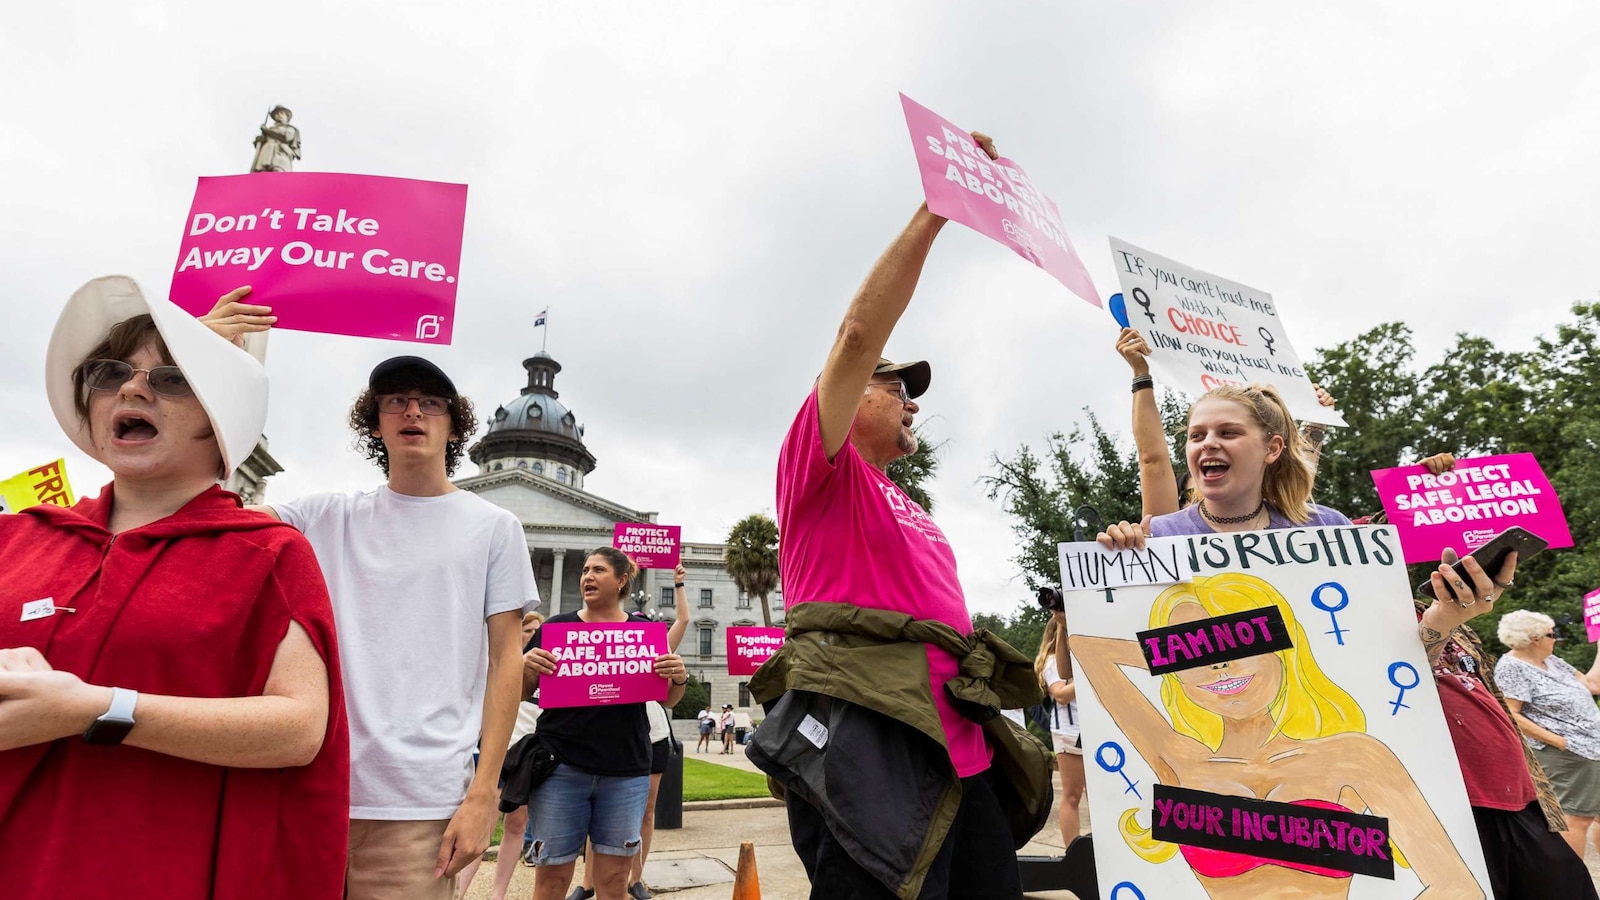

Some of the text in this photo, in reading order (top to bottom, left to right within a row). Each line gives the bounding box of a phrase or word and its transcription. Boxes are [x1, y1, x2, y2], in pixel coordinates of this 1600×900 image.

[926, 136, 1003, 189] SAFE,
[190, 208, 380, 236] Don't Take
[945, 164, 1069, 253] ABORTION
[178, 241, 455, 284] Away Our Care.
[1149, 267, 1178, 290] you
[1180, 276, 1216, 298] can't
[1216, 285, 1248, 309] trust
[1250, 298, 1276, 316] me
[1167, 307, 1248, 347] CHOICE
[1186, 341, 1212, 360] can
[1213, 348, 1240, 365] you
[1240, 353, 1274, 373] trust
[1277, 363, 1305, 378] me
[28, 460, 71, 508] FRE
[1406, 464, 1511, 491] PROTECT
[1395, 480, 1541, 510] SAFE, LEGAL
[1413, 498, 1538, 527] ABORTION
[618, 535, 676, 546] SAFE, LEGAL
[626, 527, 669, 537] PROTECT
[620, 543, 672, 554] ABORTION
[1233, 527, 1395, 569] RIGHTS
[1065, 544, 1180, 588] HUMAN
[567, 630, 645, 645] PROTECT
[735, 635, 781, 646] Together
[738, 646, 765, 658] Fight
[1145, 616, 1273, 667] I AM NOT
[551, 645, 659, 661] SAFE, LEGAL
[557, 660, 652, 677] ABORTION
[1156, 798, 1389, 861] YOUR INCUBATOR
